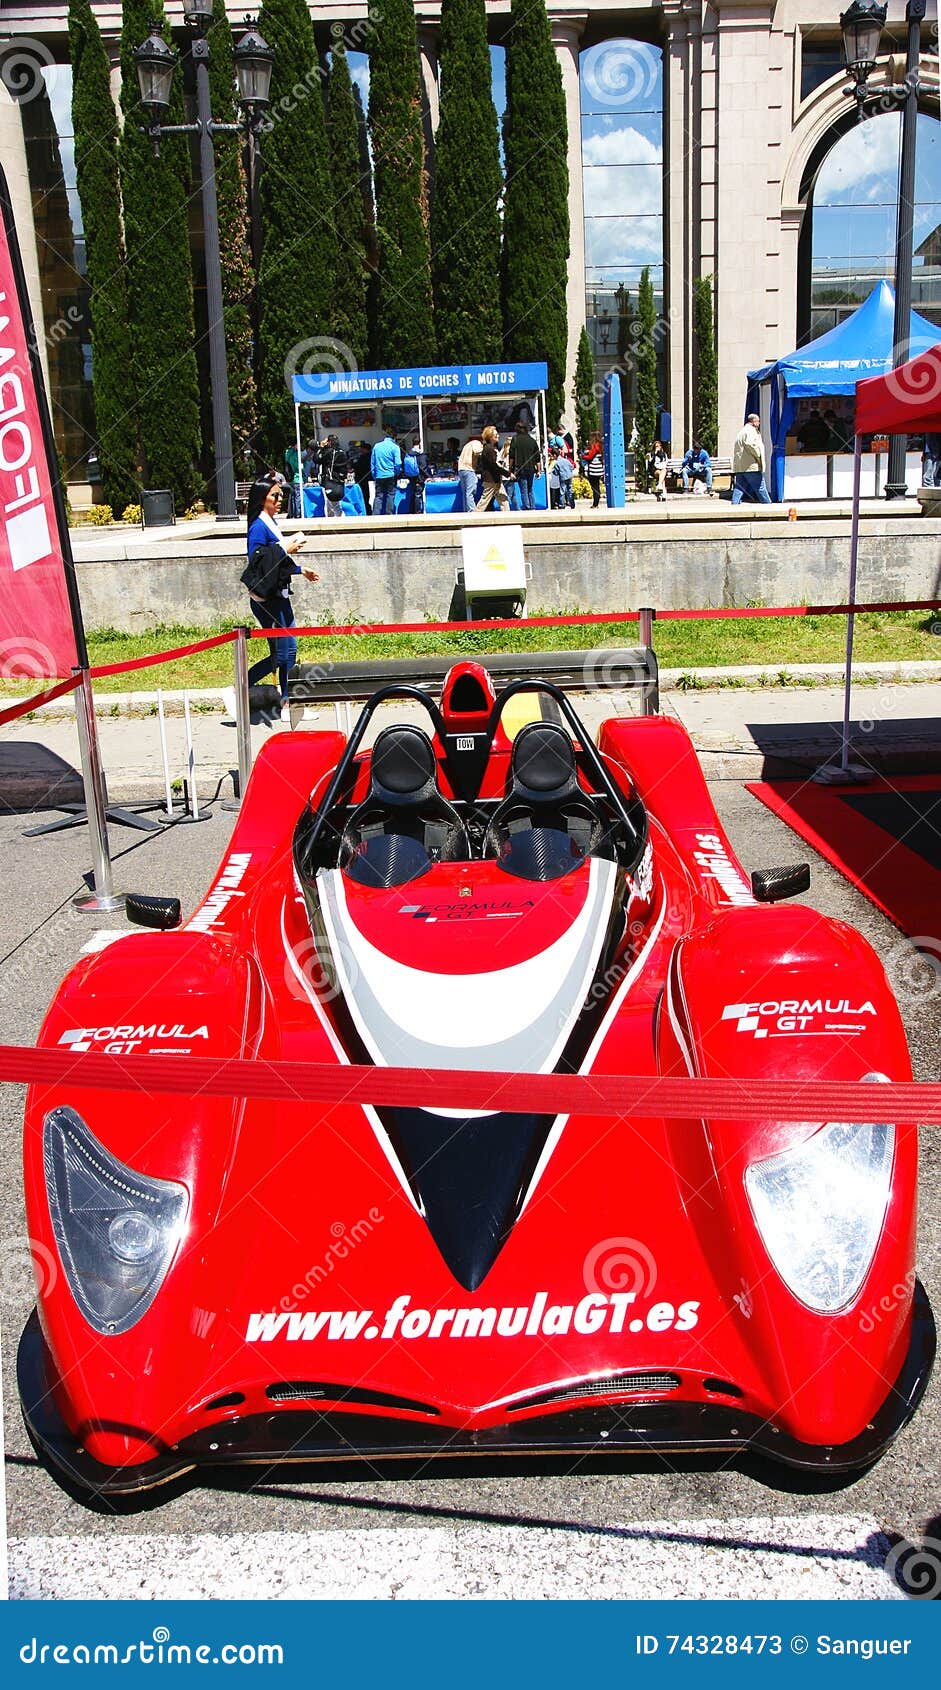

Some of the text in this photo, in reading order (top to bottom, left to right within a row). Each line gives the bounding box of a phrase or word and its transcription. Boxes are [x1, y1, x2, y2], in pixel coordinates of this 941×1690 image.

[329, 371, 516, 393] MINIATURAS DE COCHES Y MOTOS
[458, 739, 474, 748] TOW
[745, 999, 877, 1015] FORMULA
[776, 1016, 814, 1031] GT
[80, 1024, 209, 1040] FORMULA
[104, 1040, 142, 1055] GT
[245, 1291, 701, 1342] www.formulaGT.es
